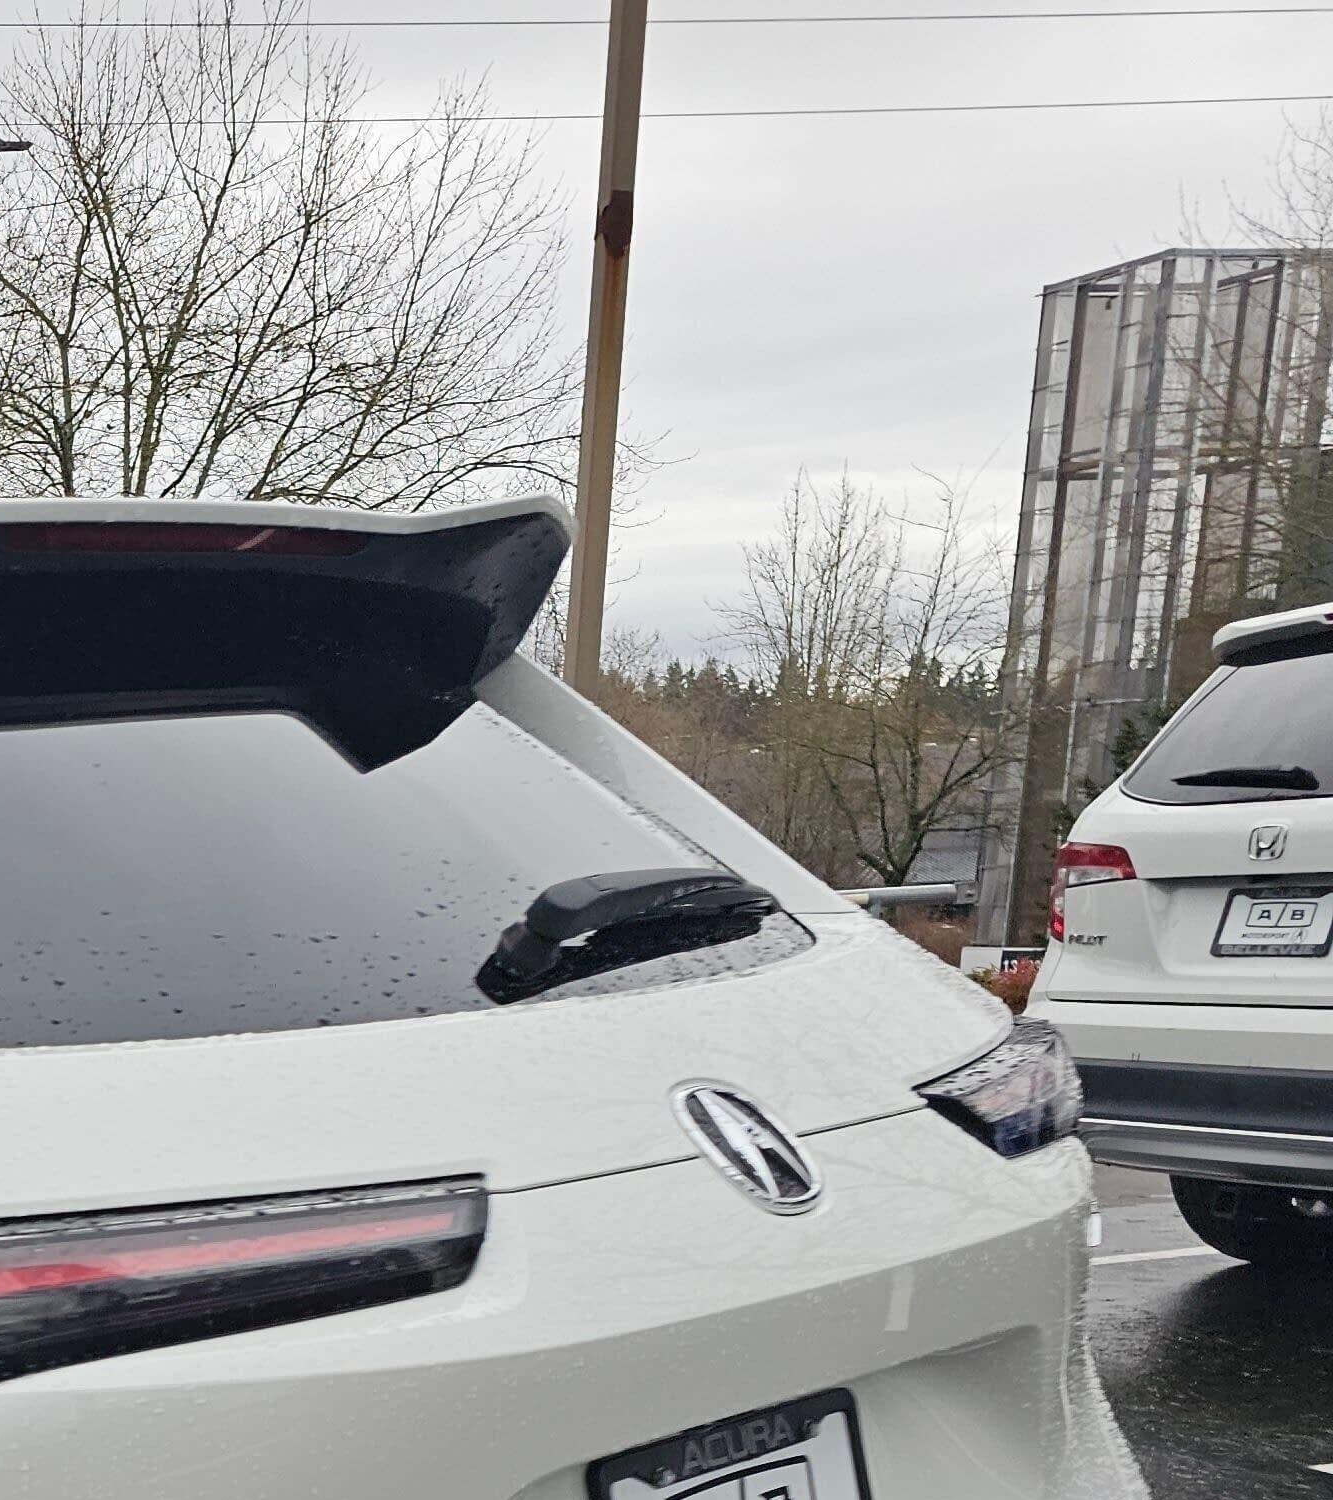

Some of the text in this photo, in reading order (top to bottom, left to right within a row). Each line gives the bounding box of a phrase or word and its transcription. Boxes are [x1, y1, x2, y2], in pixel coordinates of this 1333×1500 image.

[1257, 909, 1305, 920] A B
[682, 1413, 795, 1473] ACURA
